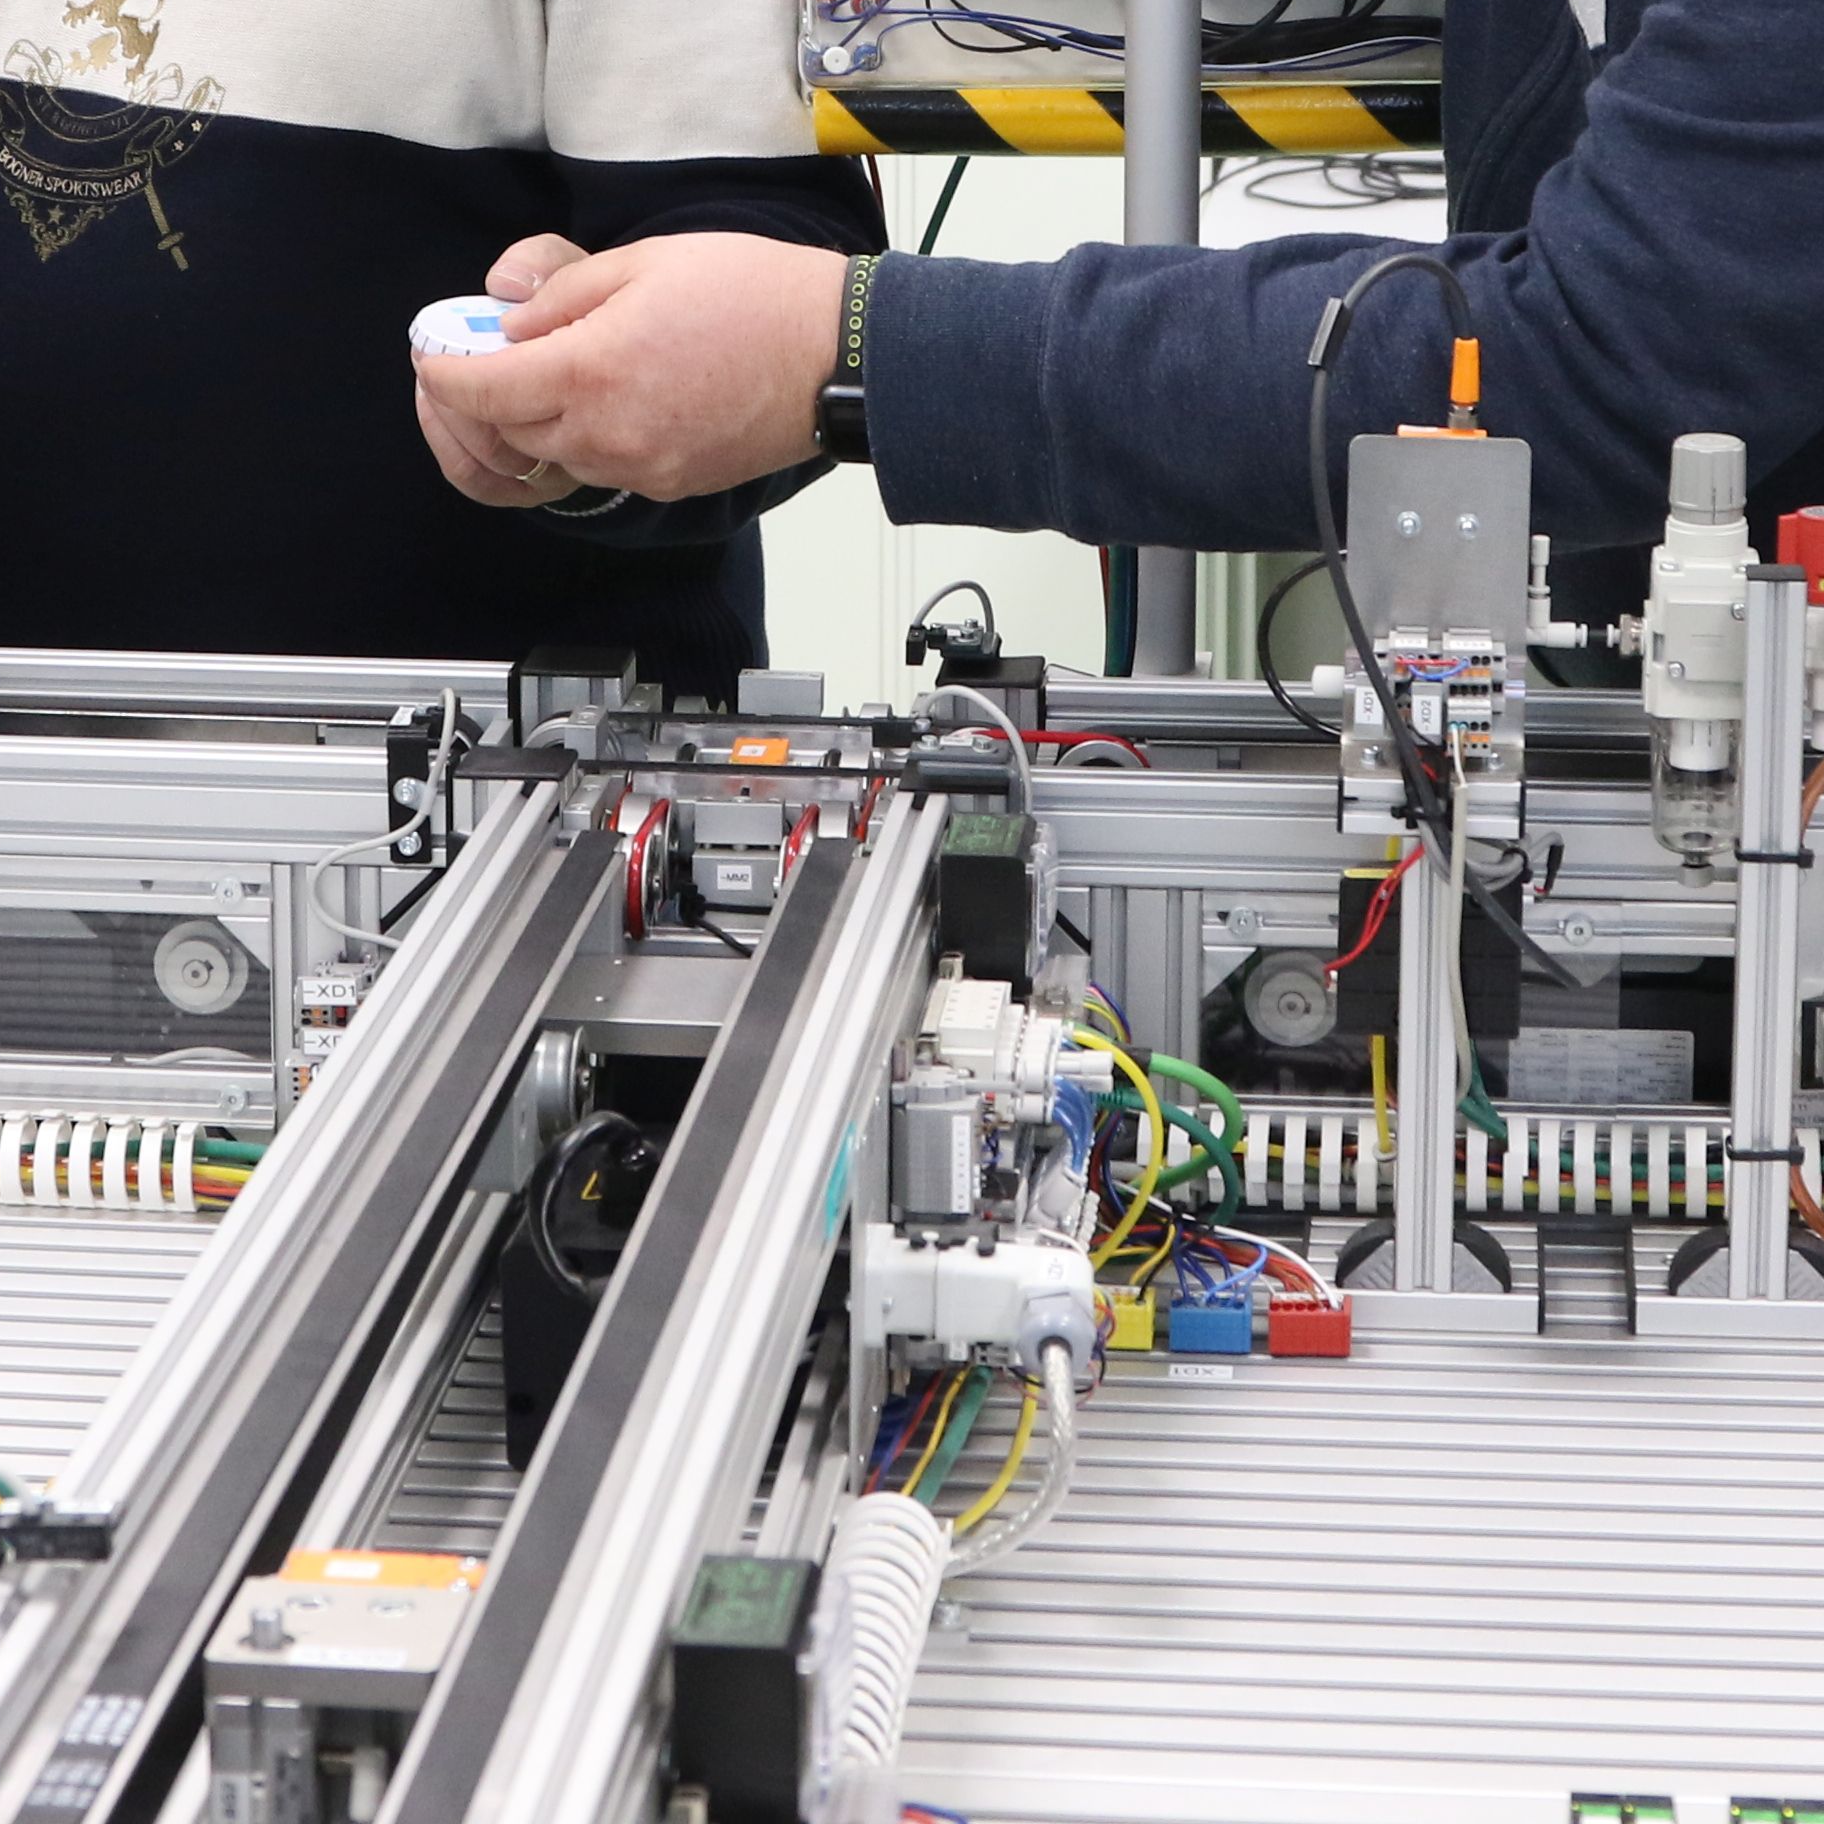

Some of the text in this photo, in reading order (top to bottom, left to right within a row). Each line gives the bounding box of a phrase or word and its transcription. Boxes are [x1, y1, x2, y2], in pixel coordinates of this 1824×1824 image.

[44, 171, 144, 197] SPORTSWEAR
[303, 983, 355, 998] -XD1
[303, 1034, 341, 1049] -X
